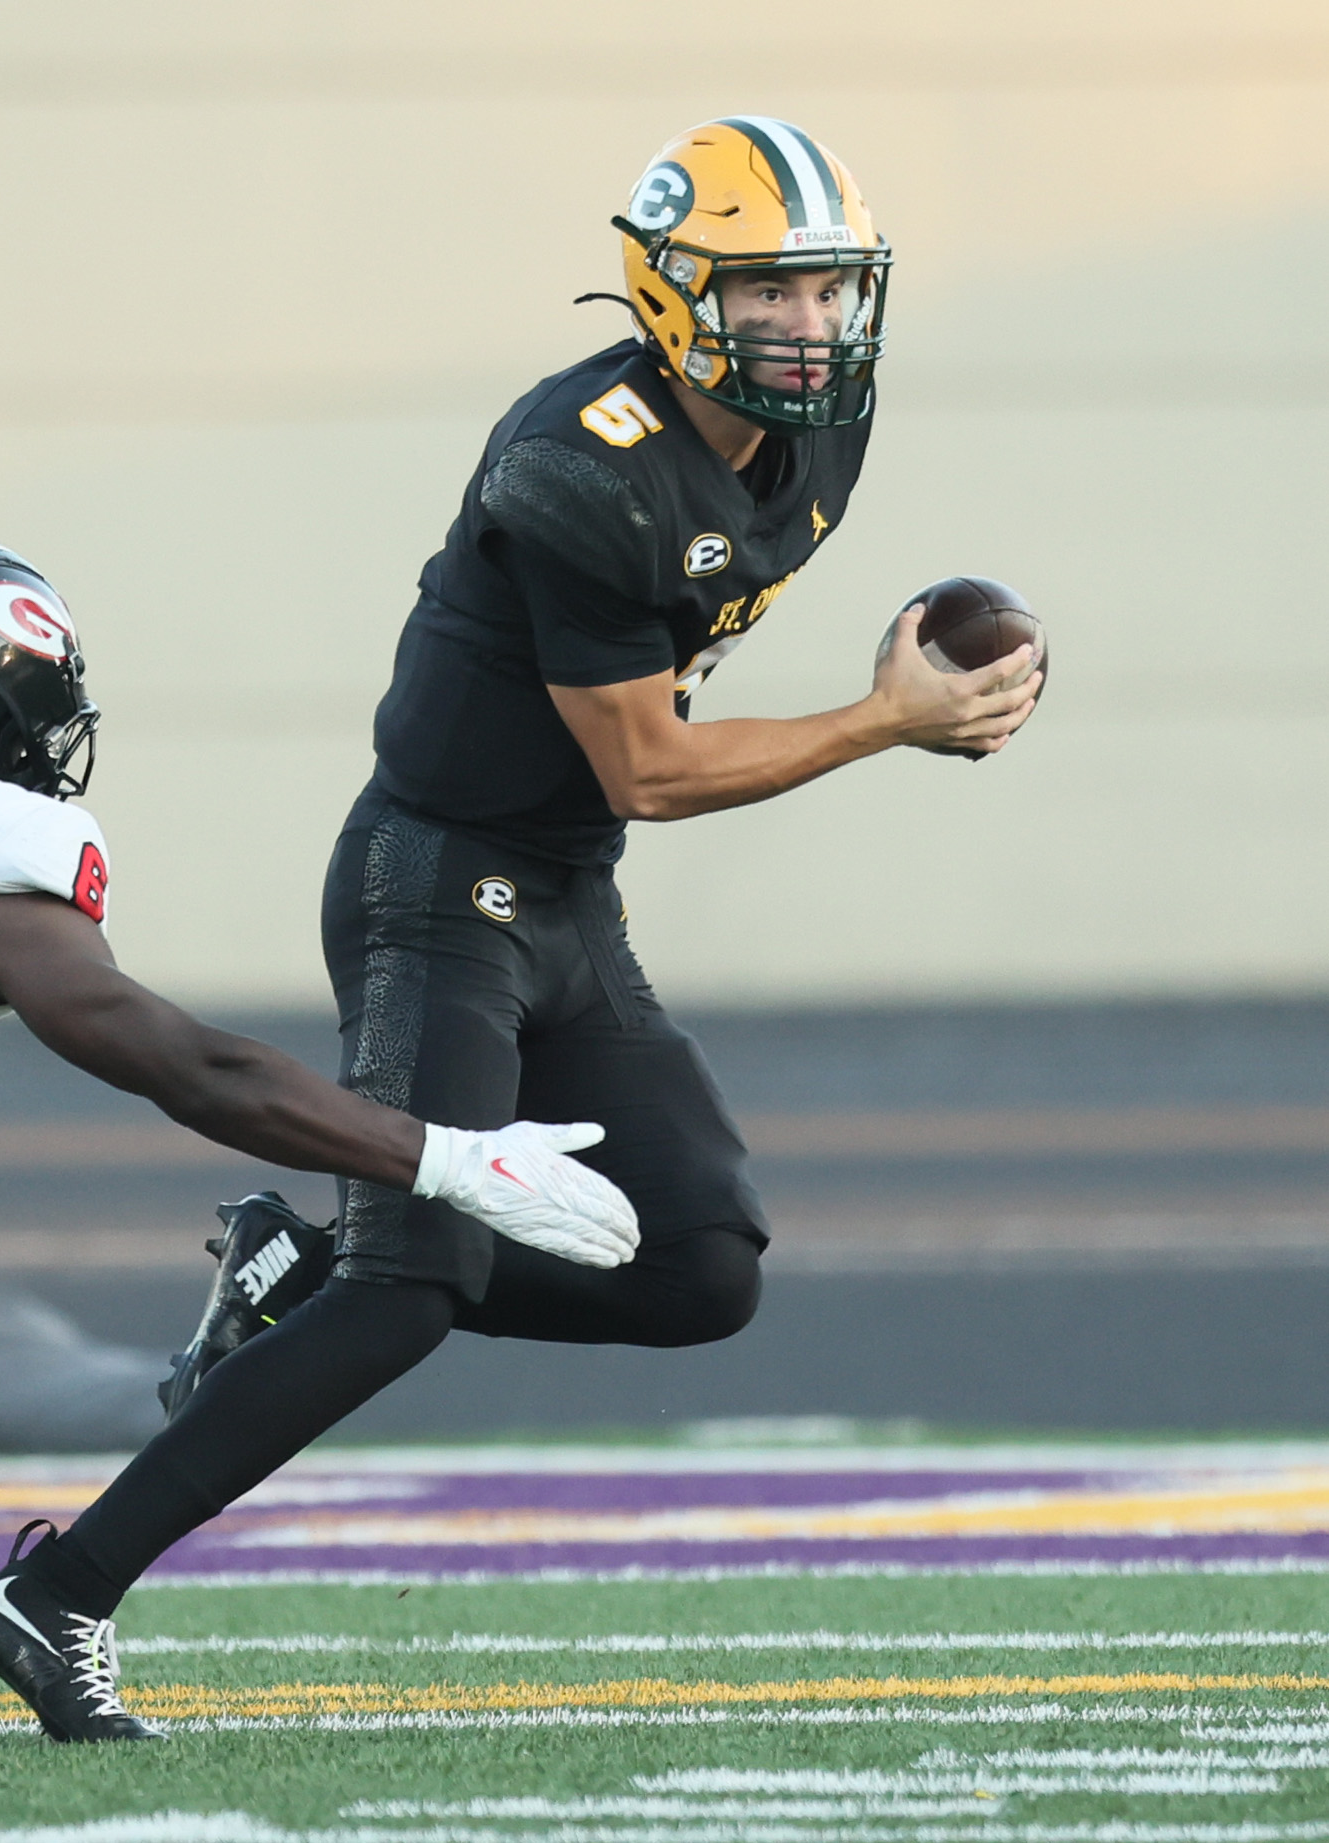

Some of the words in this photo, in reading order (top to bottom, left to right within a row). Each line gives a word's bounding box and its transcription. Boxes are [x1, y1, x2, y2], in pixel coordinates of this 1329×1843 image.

[630, 167, 688, 230] E
[579, 383, 664, 448] 5
[689, 537, 726, 574] E
[234, 1230, 300, 1306] NIKE
